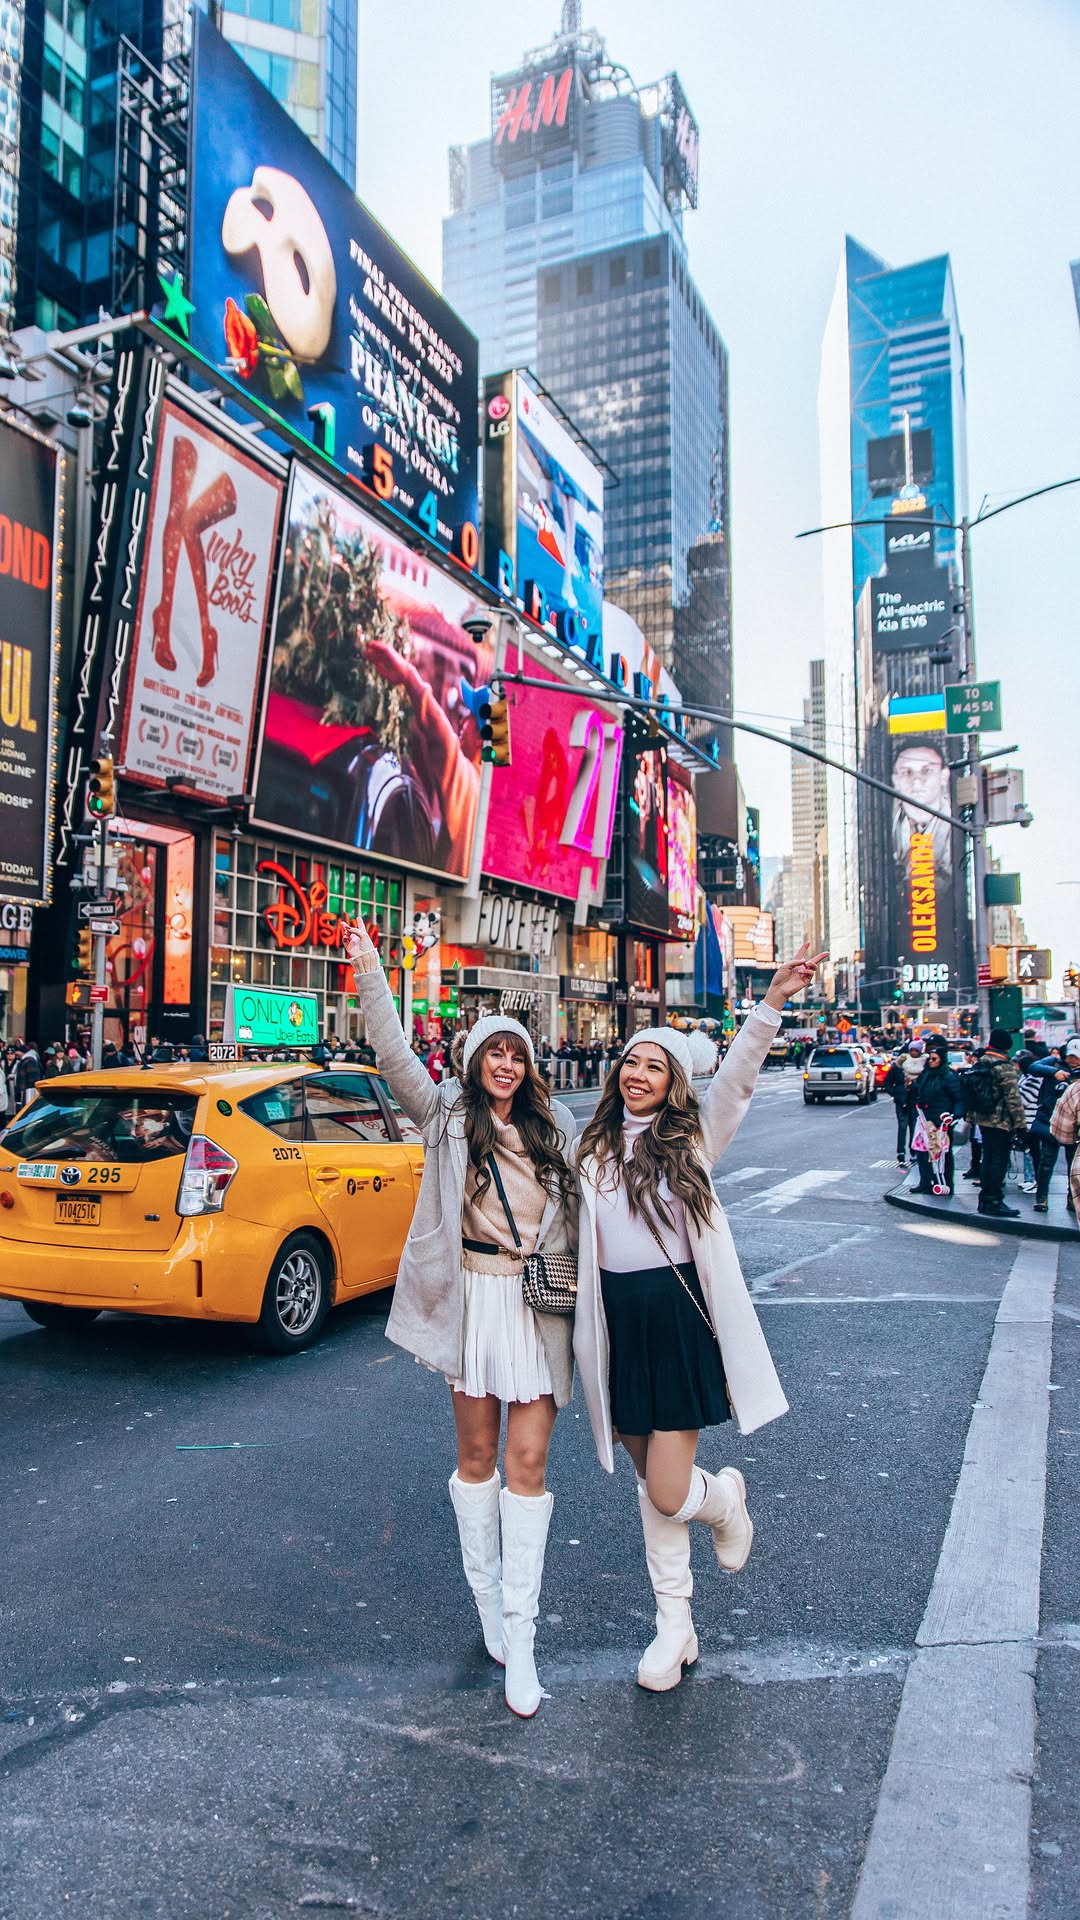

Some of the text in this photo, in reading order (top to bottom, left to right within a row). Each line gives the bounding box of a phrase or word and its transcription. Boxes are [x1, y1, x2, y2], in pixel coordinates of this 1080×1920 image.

[350, 238, 463, 376] FINAL PERFORMANCE
[363, 277, 406, 335] APRIL
[427, 344, 453, 384] 2023
[349, 334, 461, 475] PHANTOM
[489, 420, 510, 439] LG
[362, 405, 381, 433] OF
[383, 422, 410, 461] THE
[411, 448, 449, 496] OPERA
[209, 573, 259, 624] Boots
[877, 593, 902, 606] The
[877, 600, 946, 619] All-electric
[877, 614, 927, 633] Kia EV6
[0, 639, 37, 733] UL
[965, 688, 980, 700] TO
[952, 700, 994, 715] W 45 St
[1, 737, 16, 749] HIS
[559, 710, 625, 859] 21
[0, 861, 34, 876] TODAY!
[911, 832, 938, 953] OLEKSANDR
[0, 903, 34, 930] GE
[477, 889, 560, 957] FOREVER
[902, 963, 949, 982] 9 DEC
[242, 996, 286, 1024] ONLY
[275, 1027, 315, 1043] Uber Eats
[88, 1167, 121, 1183] 295
